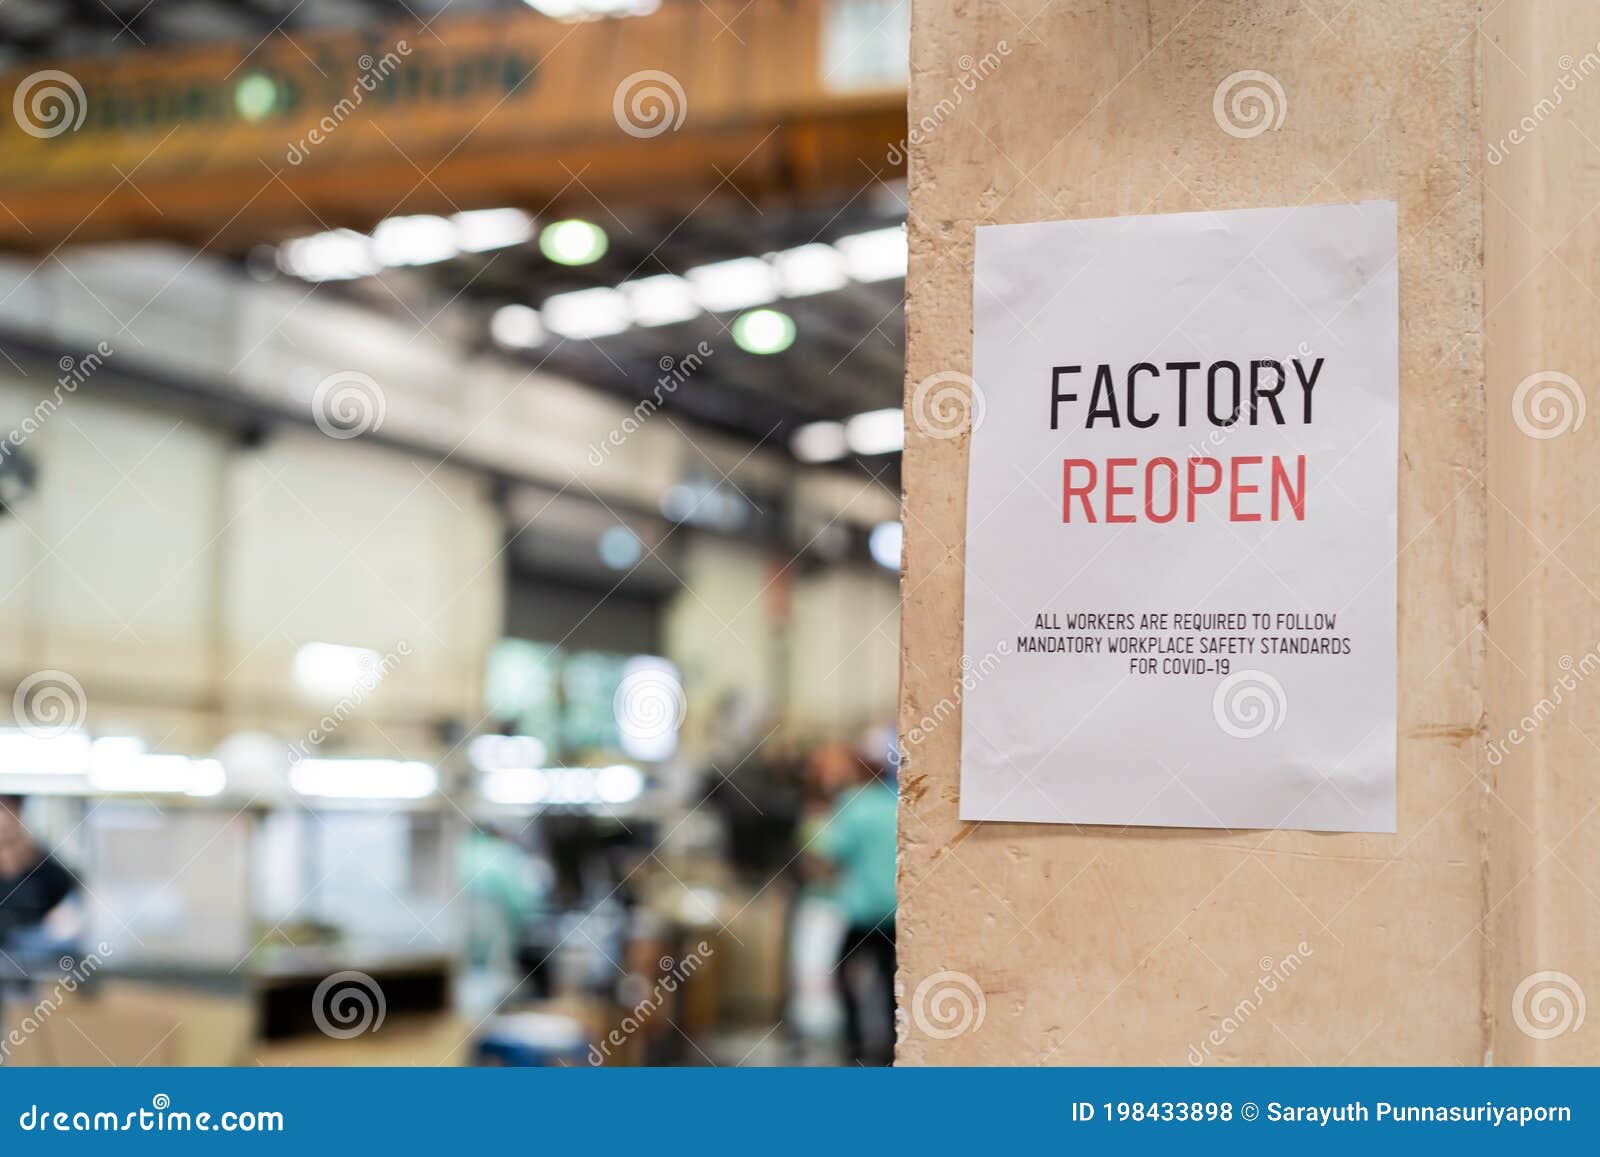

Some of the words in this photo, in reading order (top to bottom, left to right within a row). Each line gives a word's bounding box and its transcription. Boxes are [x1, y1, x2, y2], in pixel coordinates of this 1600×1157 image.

[1051, 358, 1325, 430] FACTORY
[1063, 455, 1306, 524] REOPEN
[1035, 613, 1061, 630] ALL
[1066, 613, 1135, 630] WORKERS
[1139, 613, 1169, 630] ARE
[1173, 613, 1247, 631] REQUIRED
[1252, 613, 1271, 630] TO
[1276, 613, 1337, 631] FOLLOW
[1016, 636, 1103, 654] MANDATORY
[1107, 636, 1195, 654] WORKPLACE
[1199, 637, 1256, 654] SAFETY
[1260, 637, 1352, 655] STANDARDS
[1130, 658, 1158, 675] FOR
[1162, 658, 1230, 675] COVID-19
